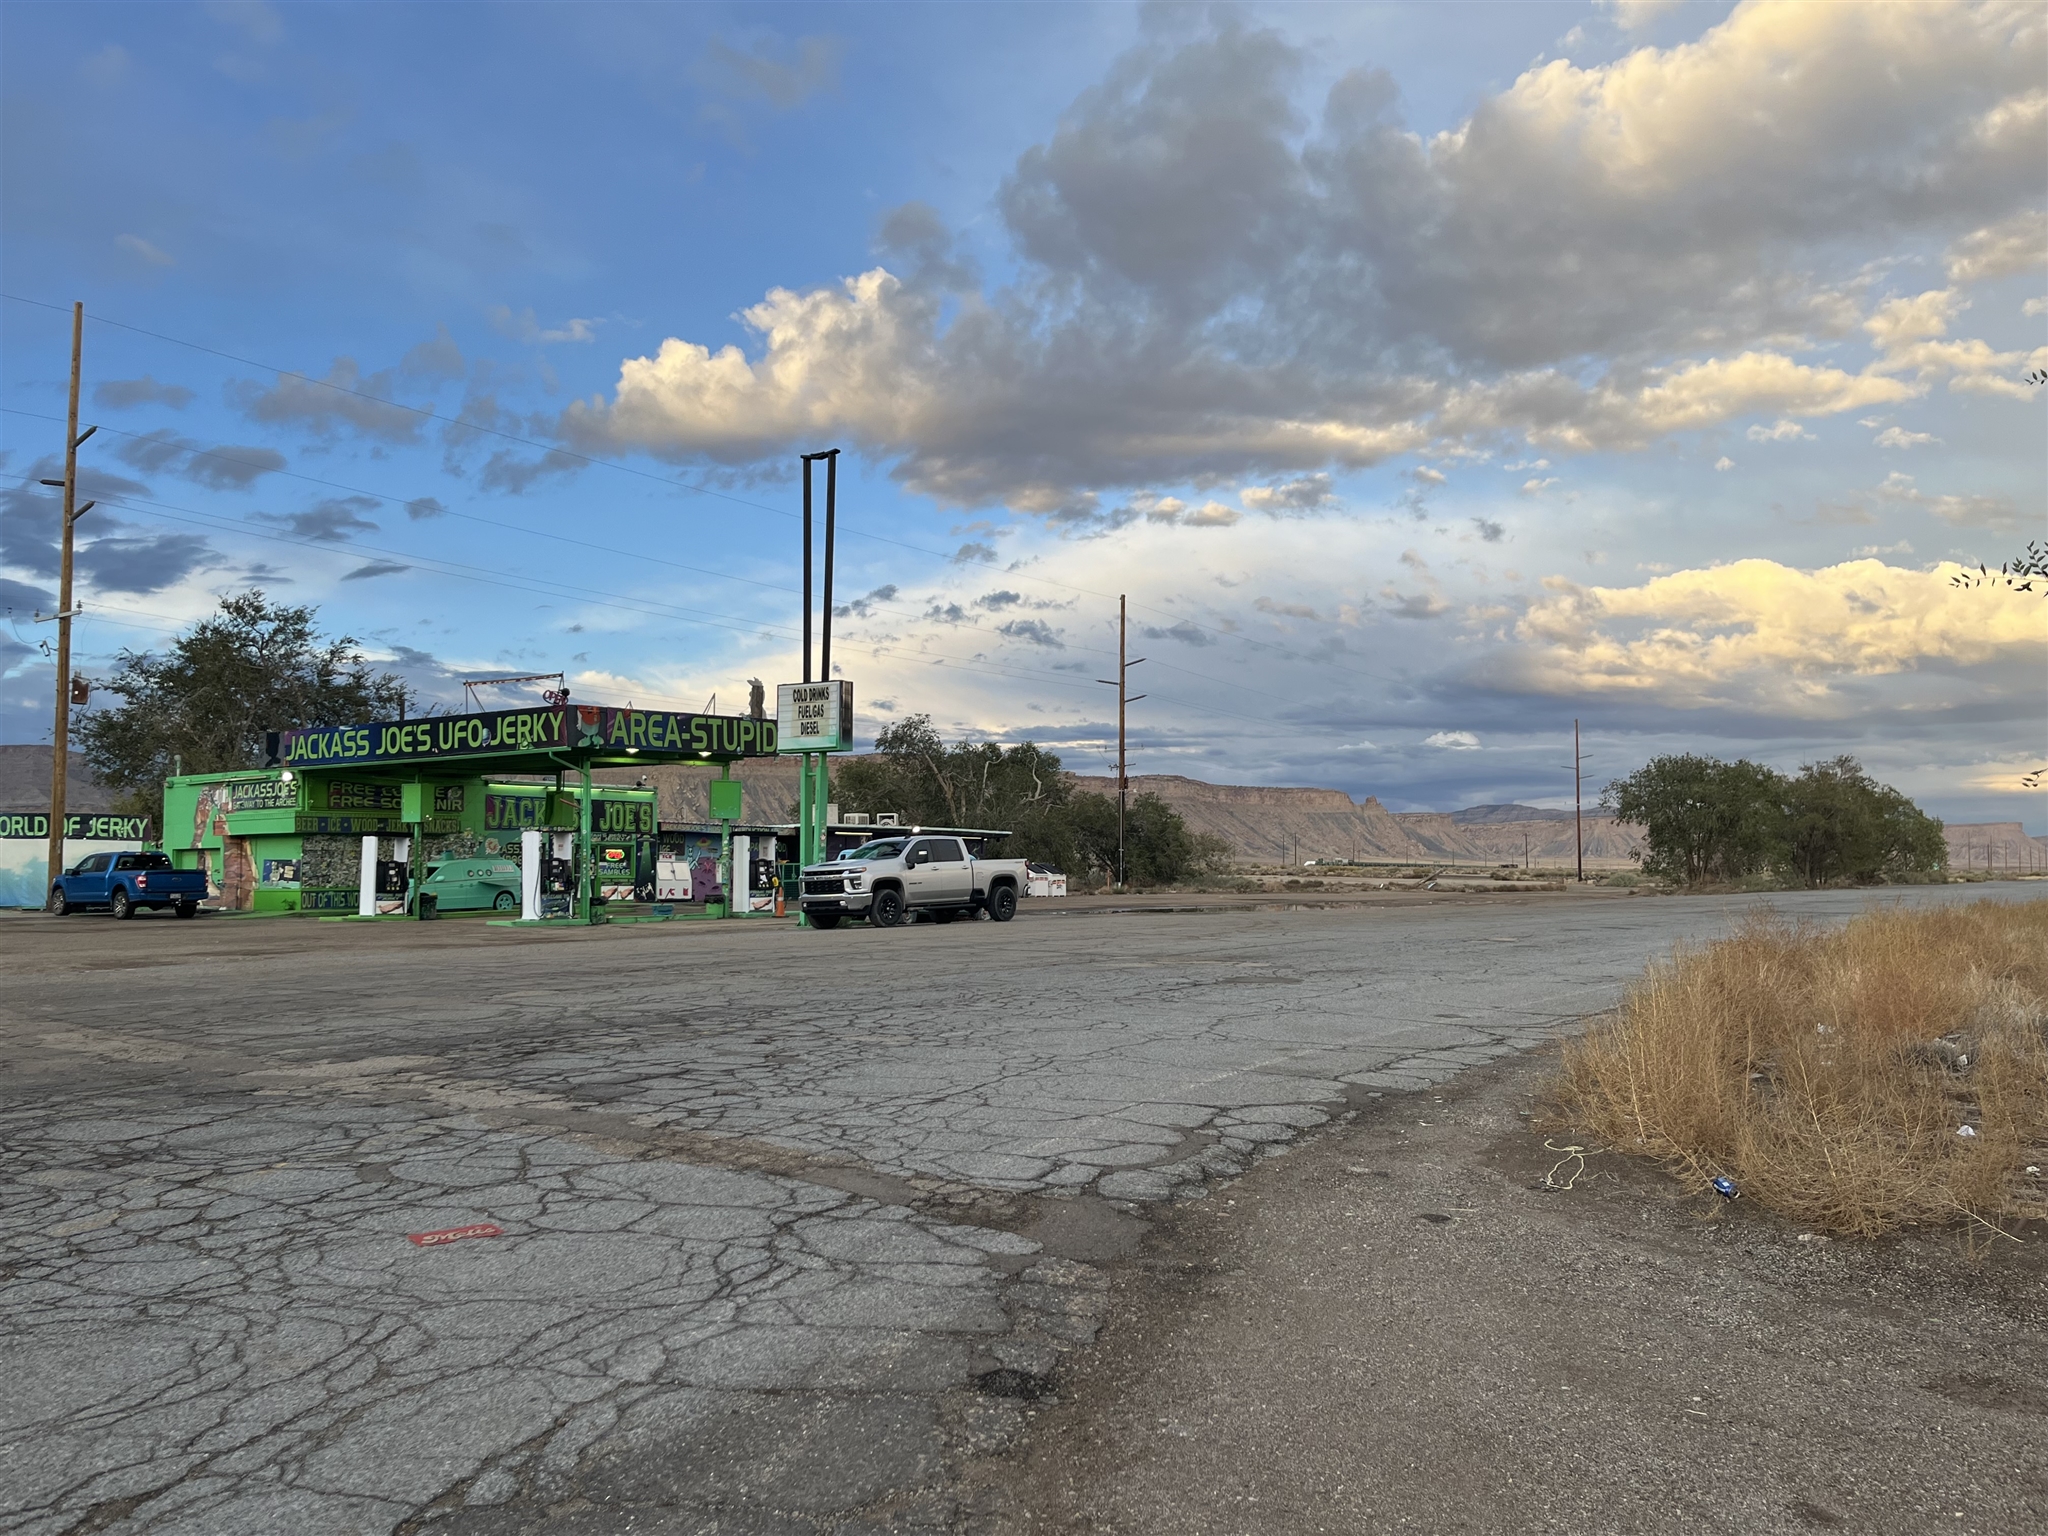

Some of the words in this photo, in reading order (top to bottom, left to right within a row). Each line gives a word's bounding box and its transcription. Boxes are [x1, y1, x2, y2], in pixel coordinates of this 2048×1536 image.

[792, 688, 808, 703] COLD
[808, 686, 829, 702] DRINKS
[286, 729, 370, 762] JACKASS
[375, 724, 431, 755] JOE'S
[439, 718, 483, 750] UFO
[490, 711, 564, 746] JERKY
[609, 711, 778, 753] AREA-STUPID
[800, 721, 820, 736] DIESEL
[330, 781, 376, 796] FREE
[330, 796, 376, 807] FREE
[599, 801, 652, 832] JOE'S
[0, 816, 48, 836] ORLD
[86, 816, 149, 838] JERKY
[605, 862, 624, 870] FREE
[302, 891, 317, 908] OUT
[318, 891, 329, 908] OF
[329, 891, 346, 907] THIS
[658, 887, 690, 897] ICE
